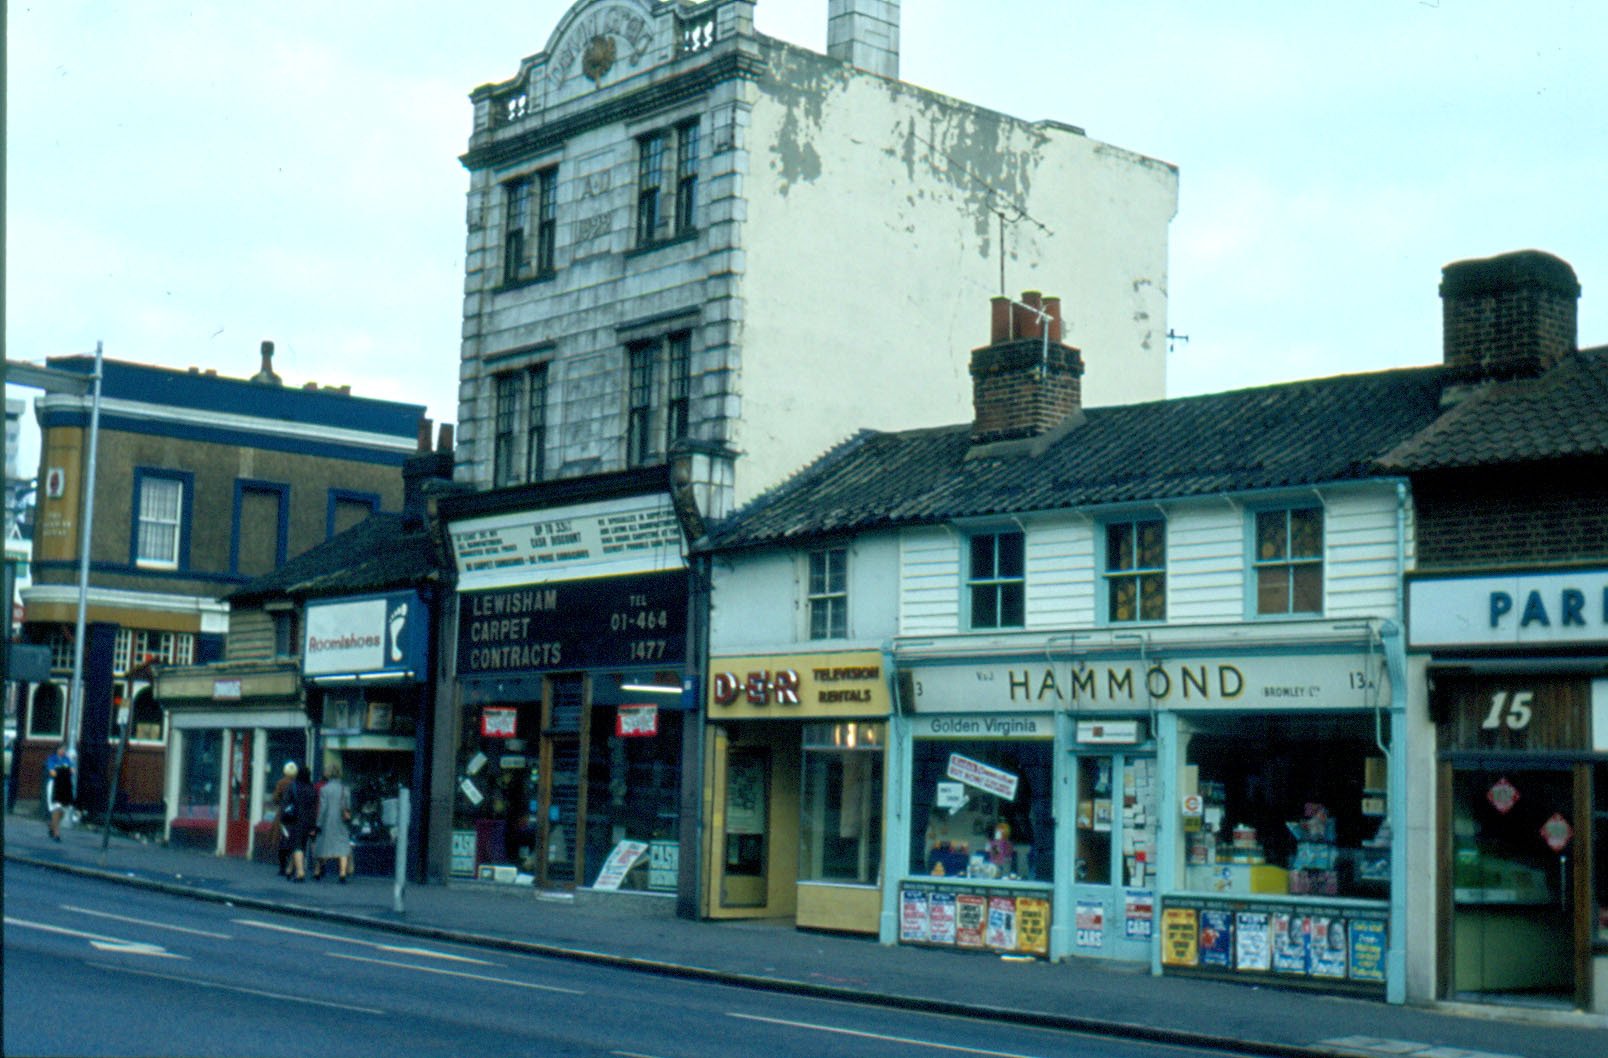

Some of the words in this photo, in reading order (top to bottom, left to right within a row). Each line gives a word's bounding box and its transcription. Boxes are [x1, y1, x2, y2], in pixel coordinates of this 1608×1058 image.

[473, 590, 557, 616] LEWISHAM
[630, 595, 647, 607] TEL
[1489, 587, 1608, 628] PAR
[471, 618, 530, 641] CARPET
[611, 610, 667, 631] 01-464
[470, 642, 562, 669] CONTRACTS
[630, 640, 666, 660] 1477
[813, 667, 878, 681] TELEVISION
[1009, 666, 1244, 700] HAMMOND
[1263, 686, 1305, 698] BROMLEY
[819, 690, 871, 703] RENTALS
[1482, 691, 1533, 729] 15
[931, 719, 979, 733] Golden
[984, 717, 1036, 736] Virginia
